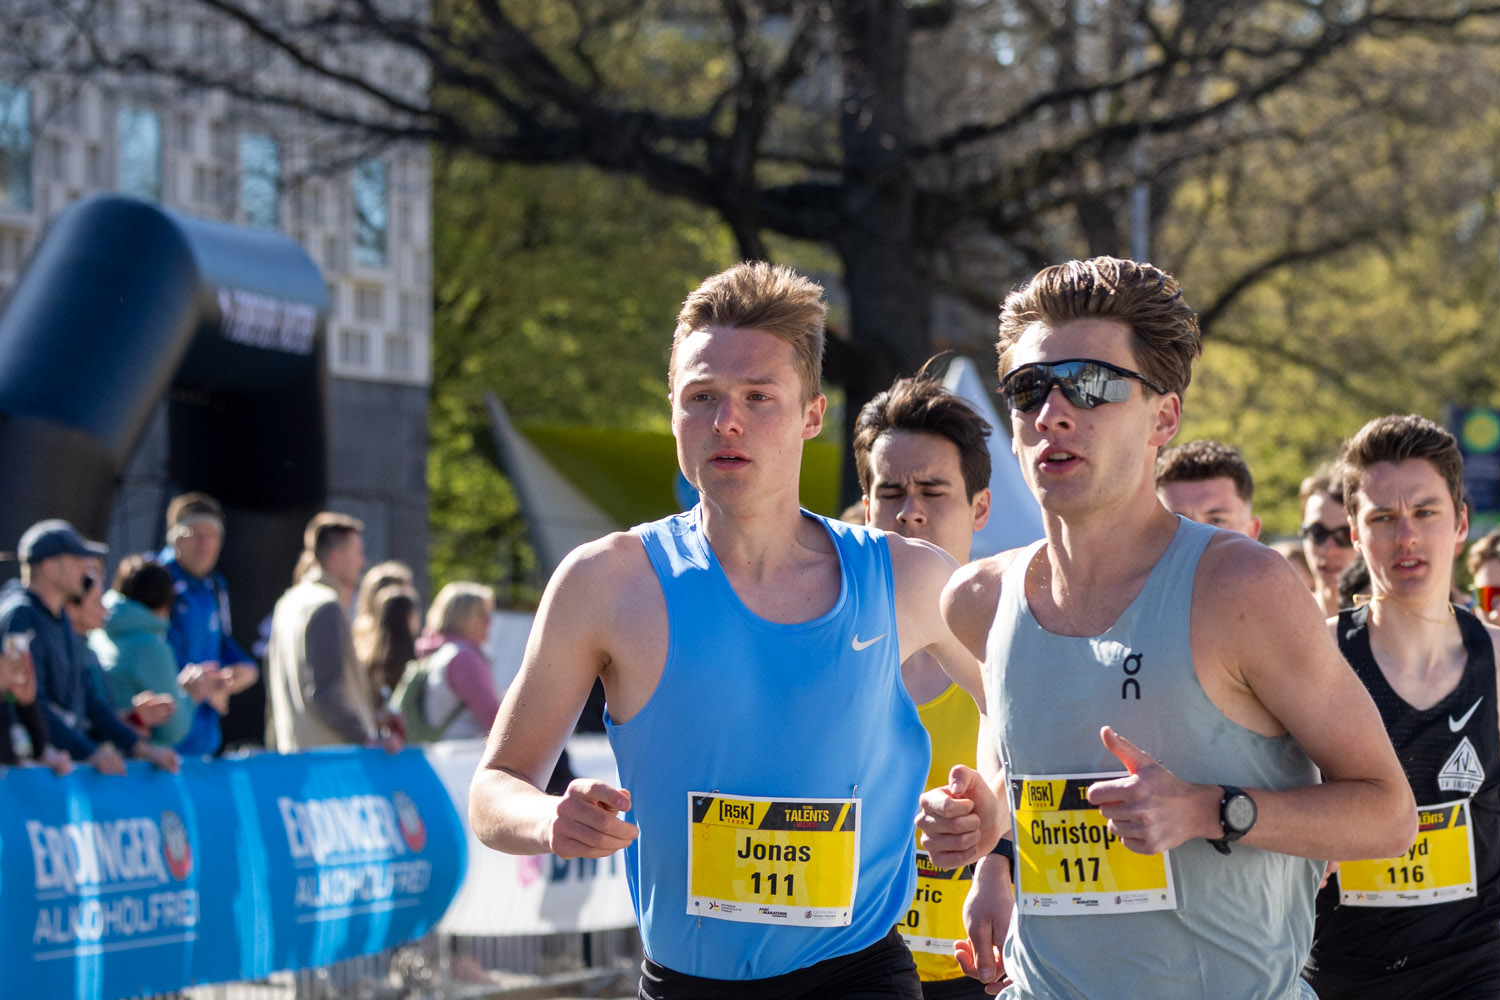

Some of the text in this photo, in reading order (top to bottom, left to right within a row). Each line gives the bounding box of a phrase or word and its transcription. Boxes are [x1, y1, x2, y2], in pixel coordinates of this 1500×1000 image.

[785, 809, 830, 823] TALENTS
[1031, 819, 1123, 850] Christop
[737, 836, 811, 863] Jonas
[1060, 857, 1100, 883] 117
[1387, 865, 1424, 884] 116
[751, 872, 794, 896] 111
[916, 884, 943, 904] ric
